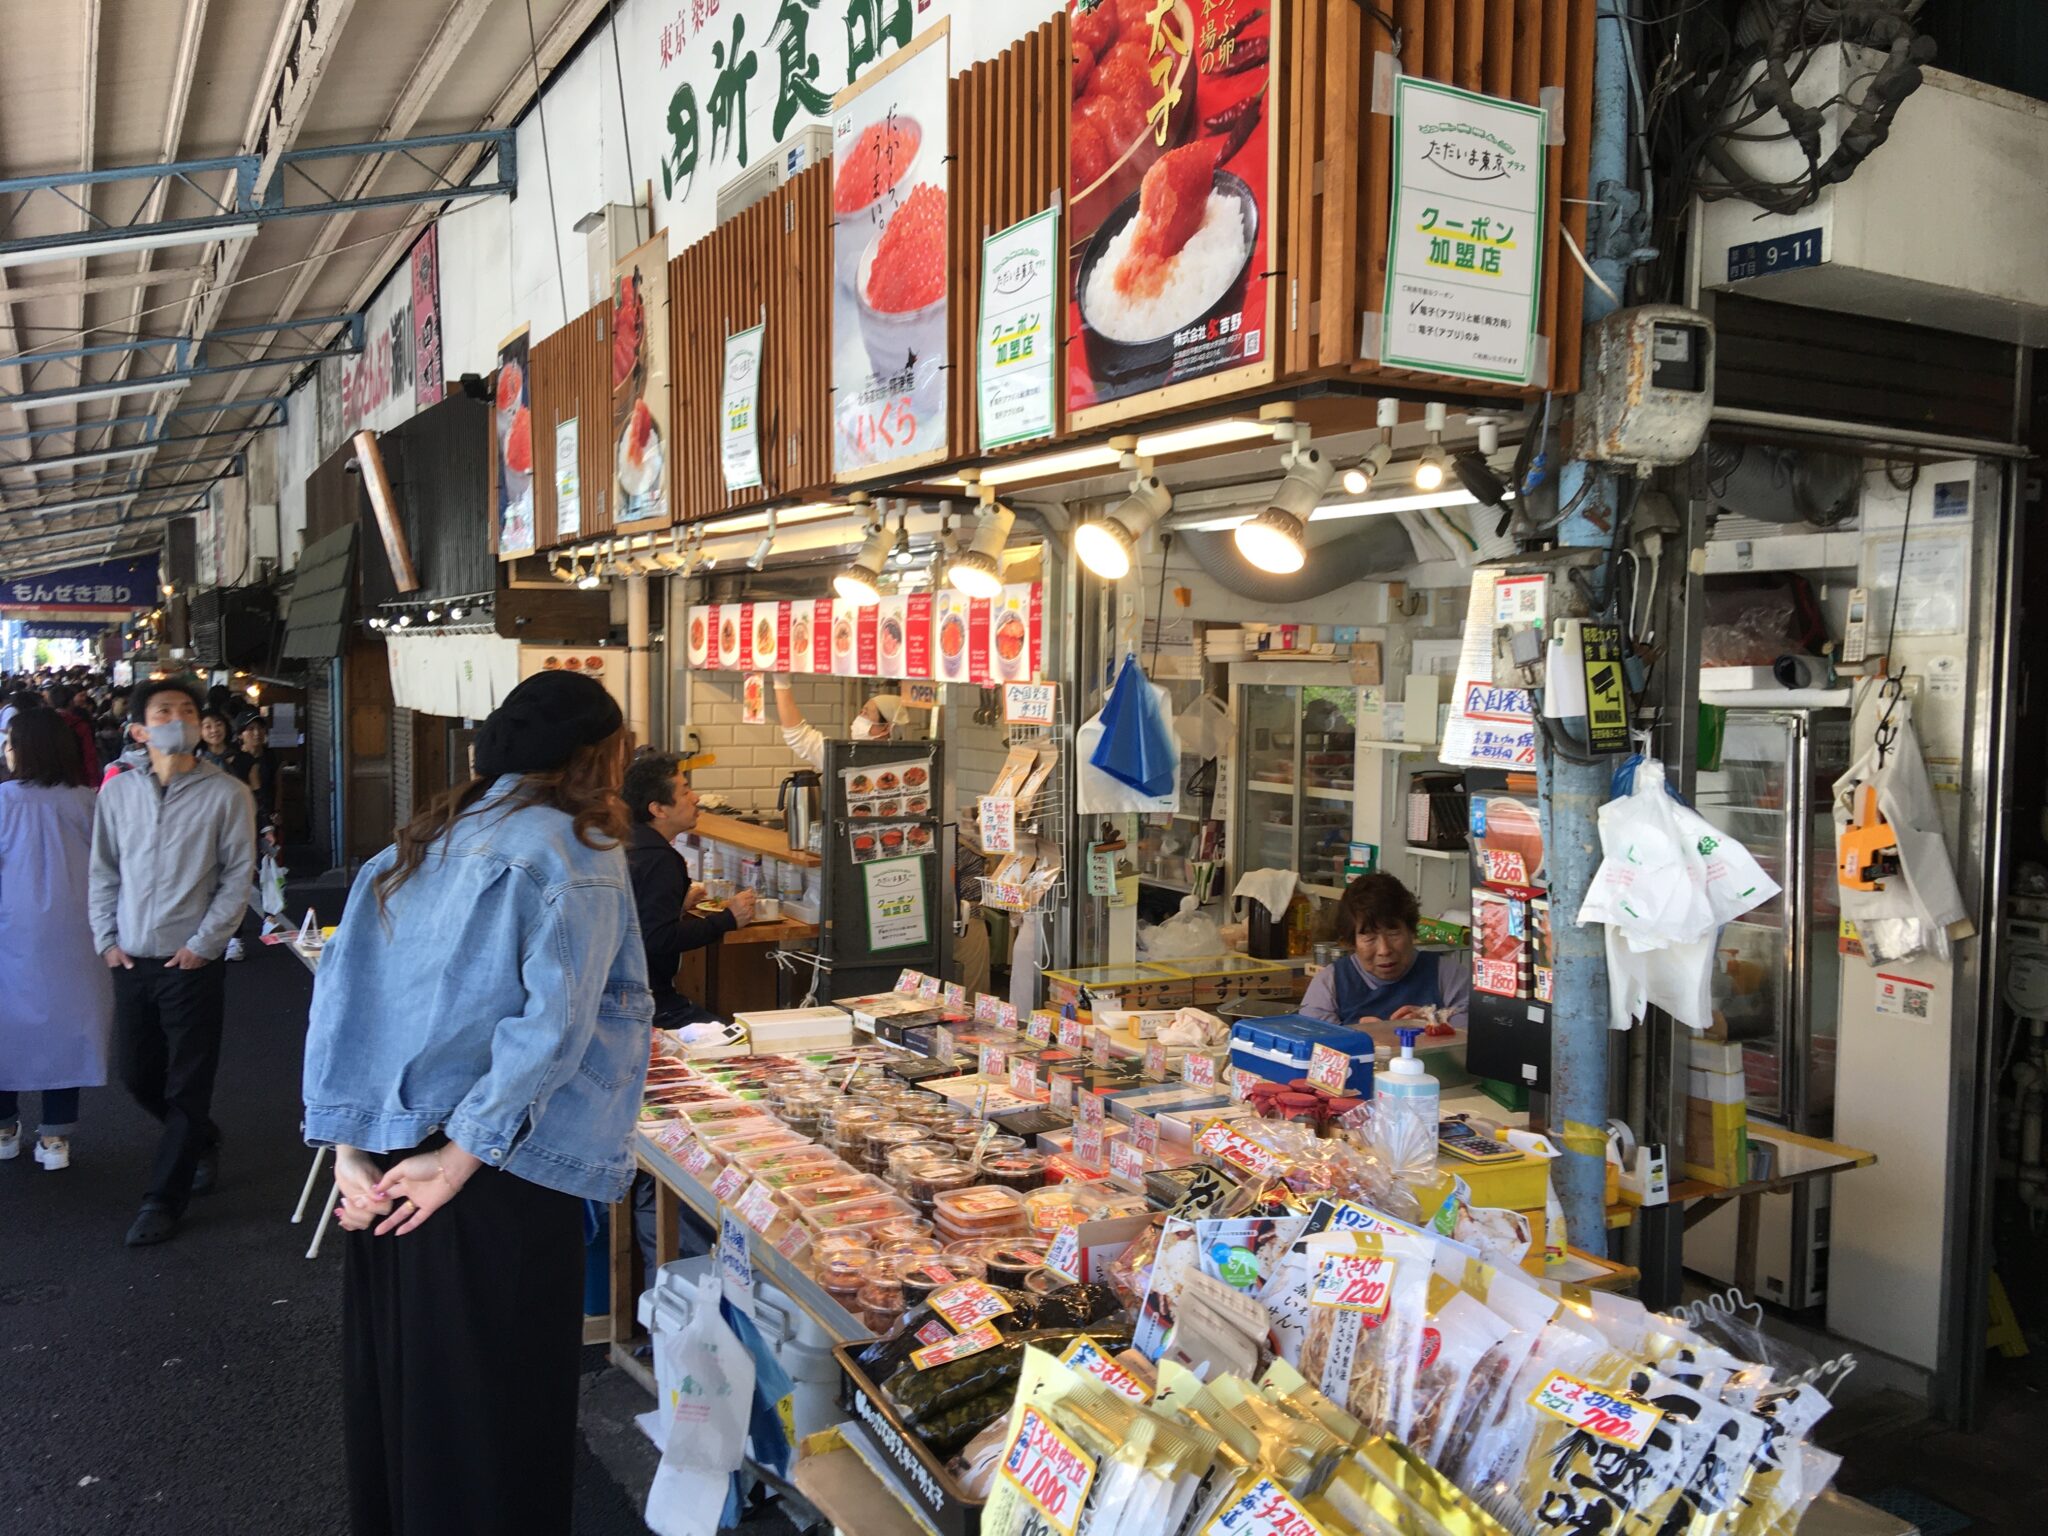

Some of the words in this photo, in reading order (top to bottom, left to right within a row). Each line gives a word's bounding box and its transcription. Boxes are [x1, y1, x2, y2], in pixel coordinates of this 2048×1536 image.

[658, 7, 686, 73] 東京
[1421, 139, 1505, 172] ただいま東京
[1506, 159, 1526, 172] プラス
[870, 135, 886, 231] うまい。
[1420, 206, 1515, 245] クーポン
[1429, 236, 1502, 274] 加盟店
[1766, 238, 1812, 267] 9-11
[992, 312, 1041, 343] クーポン
[1418, 324, 1480, 342] 電子(アプリ)のみ
[996, 335, 1034, 364] 加盟店
[856, 396, 918, 453] いくら
[12, 583, 132, 603] もんぜき通り
[1334, 1204, 1375, 1229] イワシ
